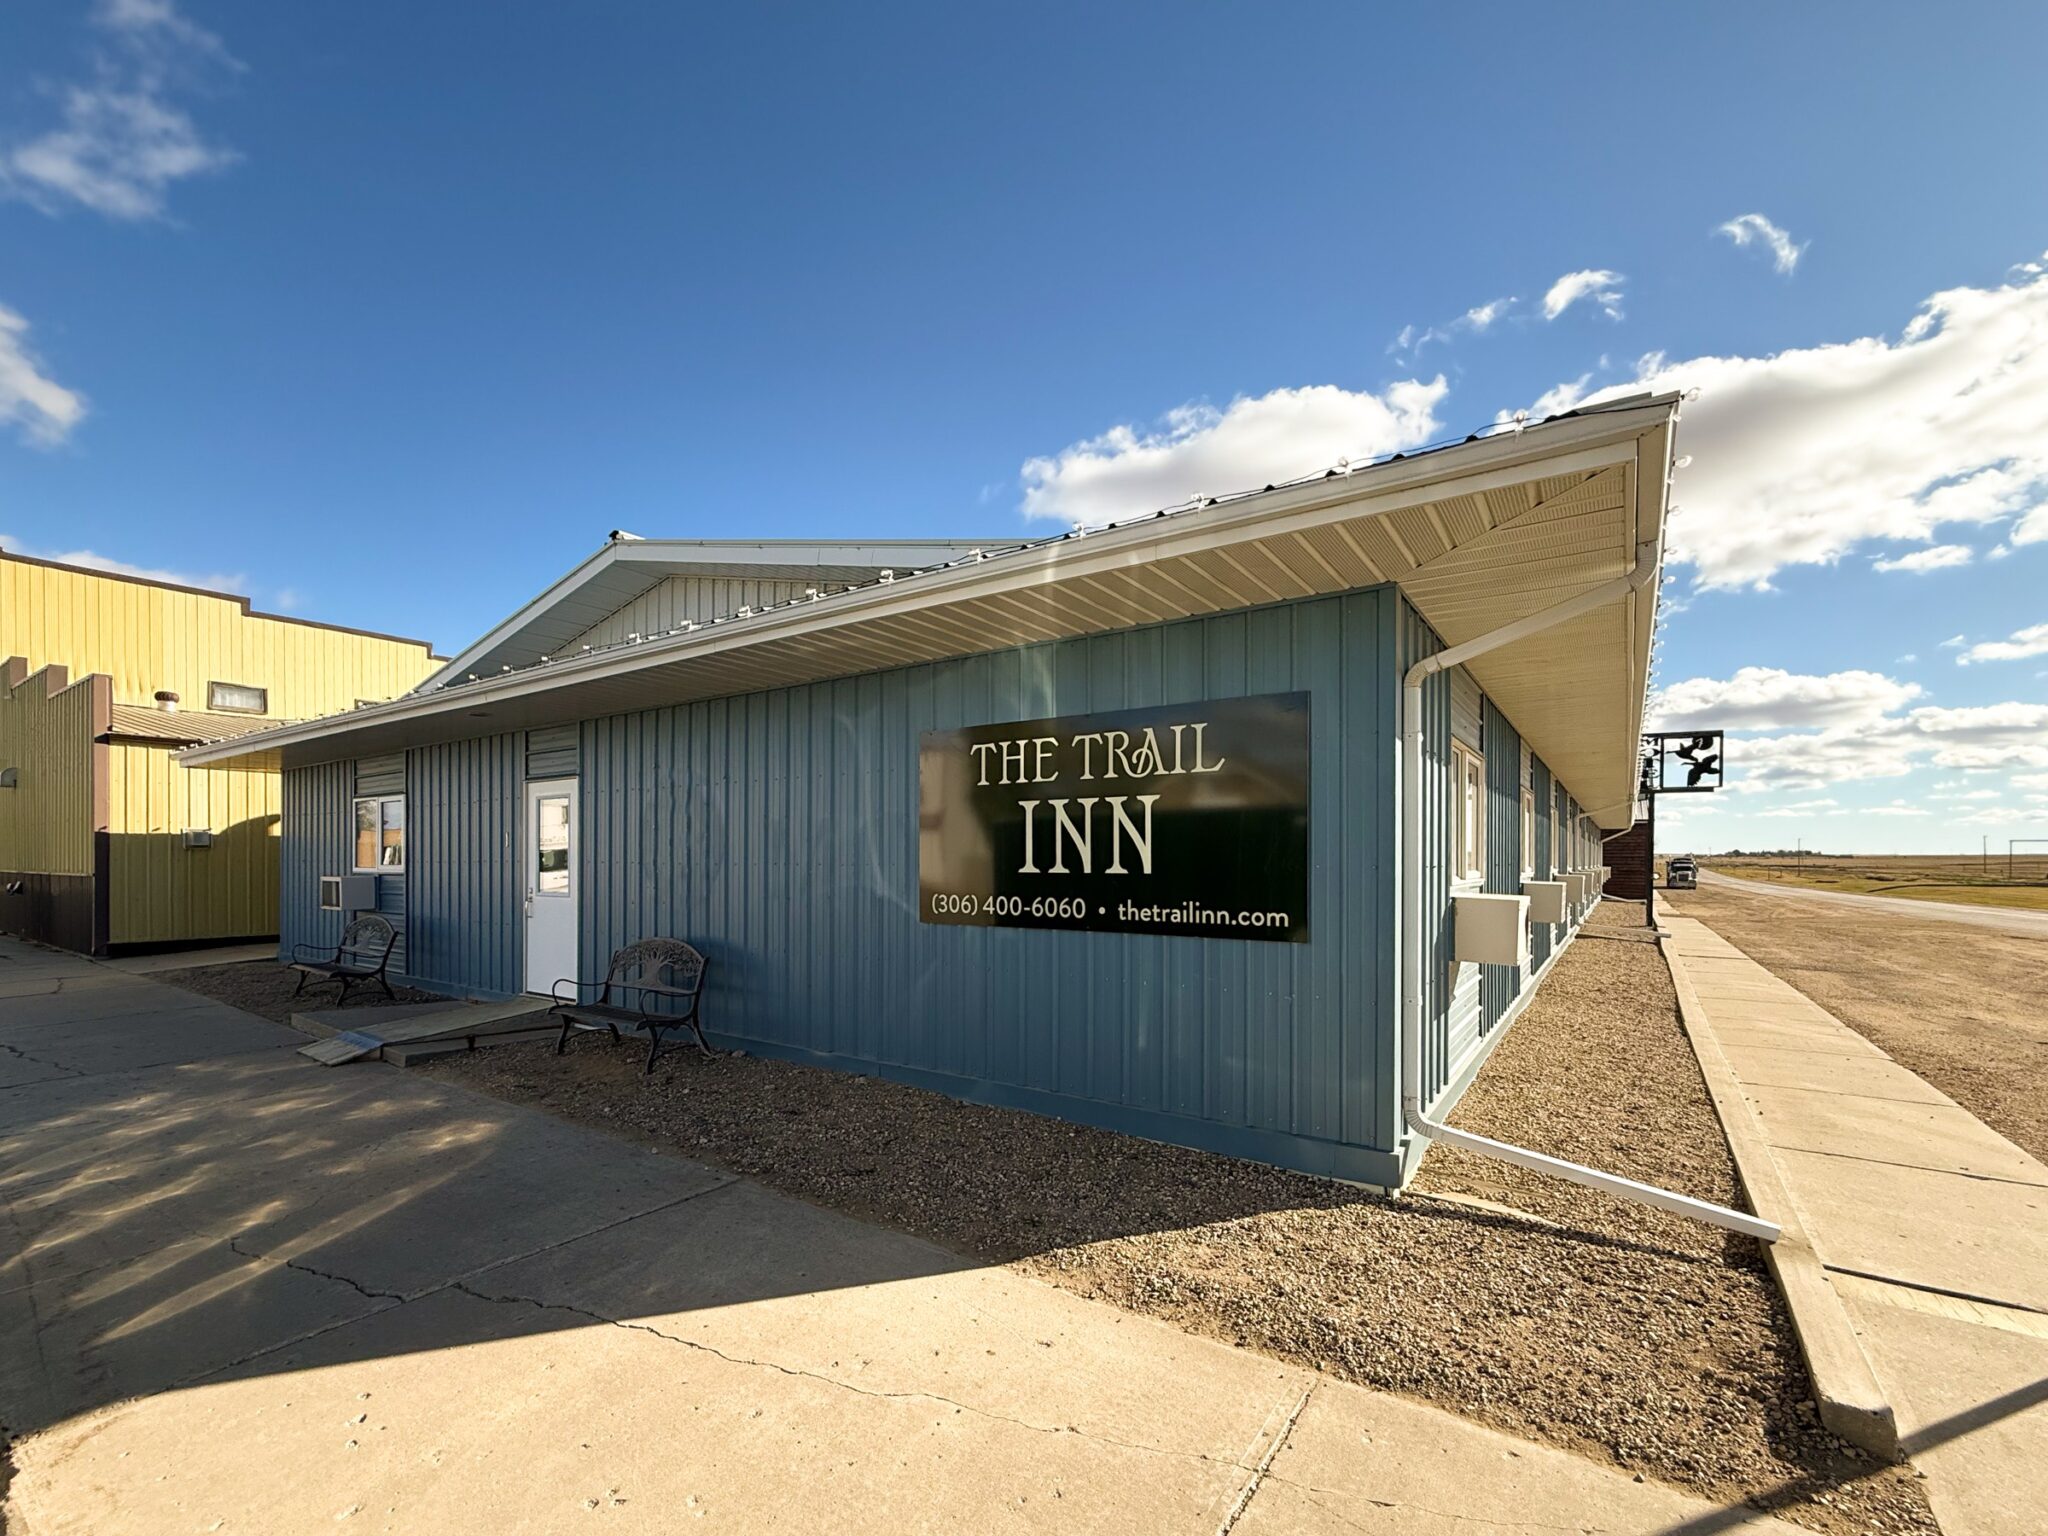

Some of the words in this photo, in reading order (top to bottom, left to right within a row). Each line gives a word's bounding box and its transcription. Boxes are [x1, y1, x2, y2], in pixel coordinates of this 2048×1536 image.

[969, 736, 1059, 786] THE
[1071, 722, 1226, 780] TRAIL
[1017, 794, 1161, 875] INN
[931, 893, 978, 916] (306)
[982, 895, 1087, 920] 400-6060
[1118, 899, 1290, 928] thetrailinn.com
